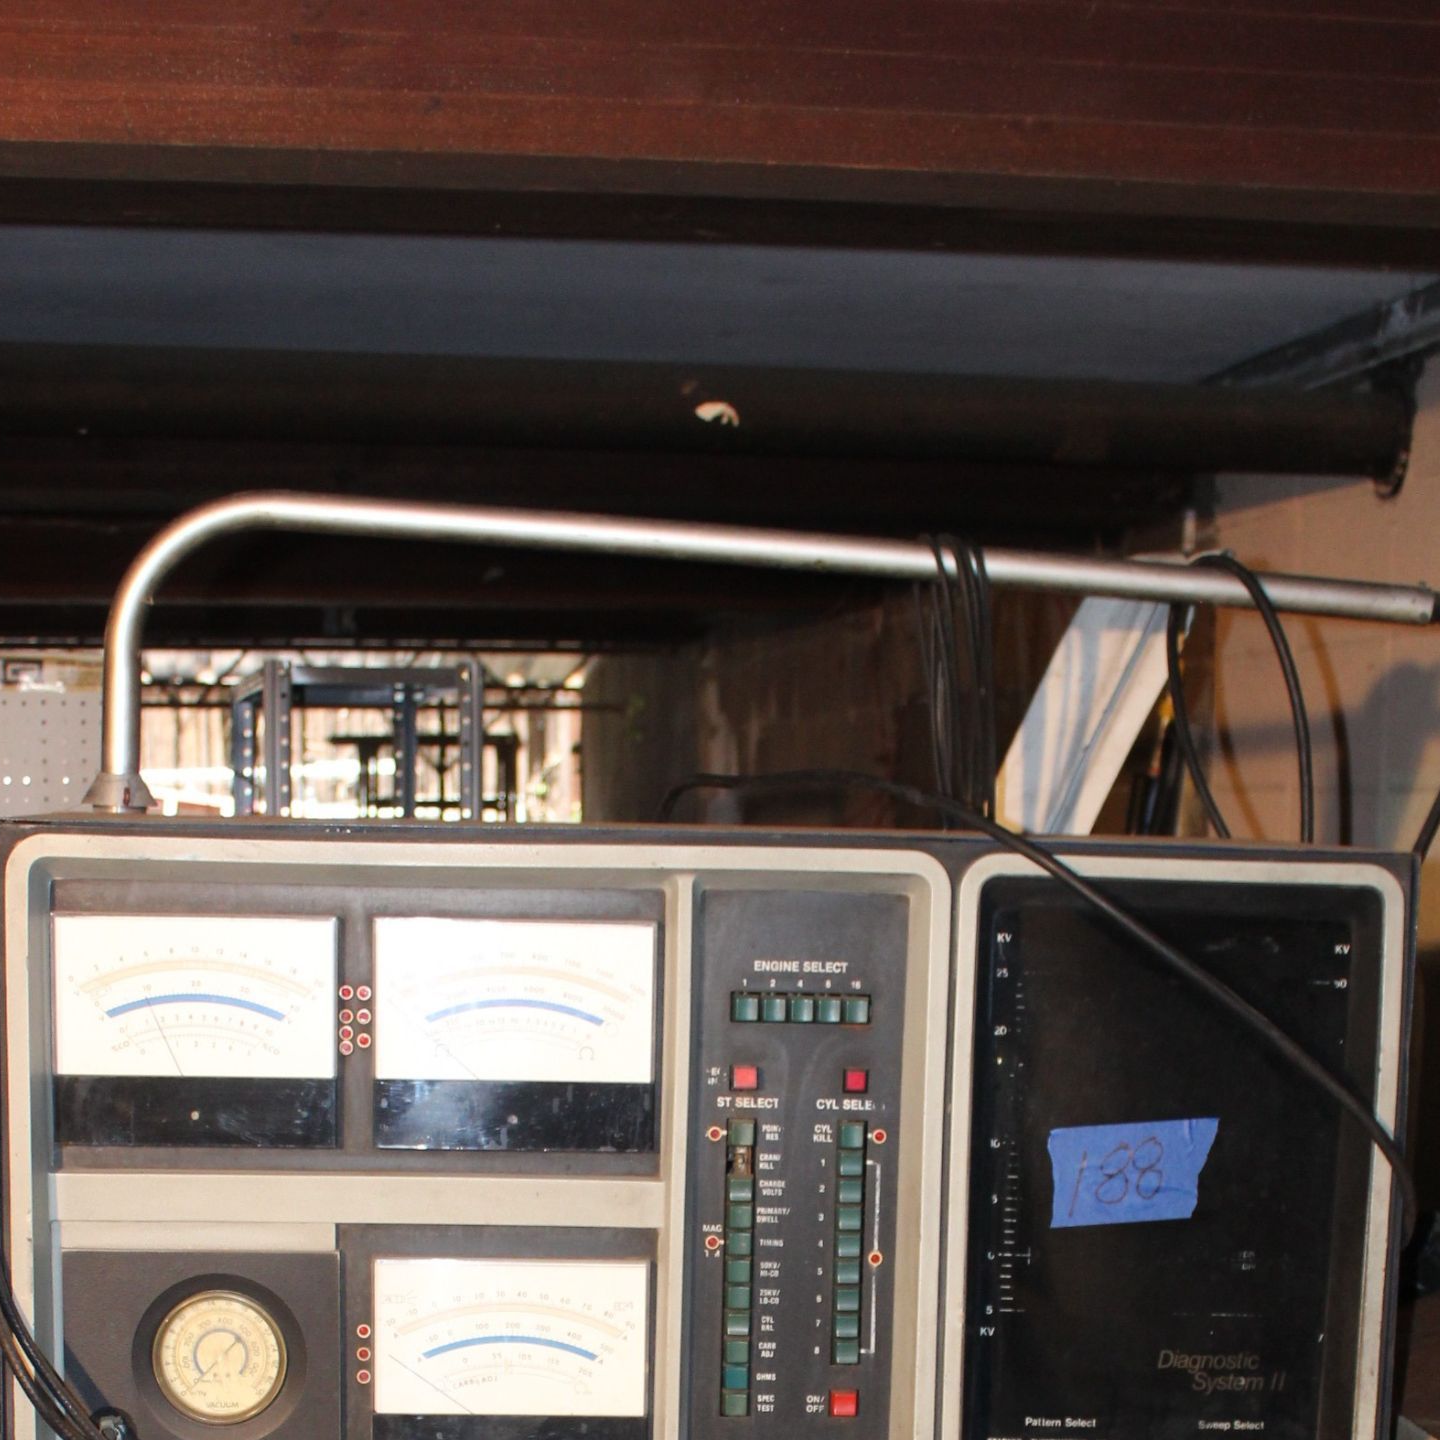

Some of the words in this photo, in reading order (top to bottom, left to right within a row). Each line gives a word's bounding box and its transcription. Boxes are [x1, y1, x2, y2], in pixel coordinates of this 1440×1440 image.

[997, 932, 1012, 943] KV
[1334, 944, 1351, 955] KV
[754, 960, 799, 973] ENGINE
[802, 961, 848, 973] SELECT
[742, 979, 747, 987] 1
[770, 979, 776, 988] 2
[797, 979, 803, 988] 4
[994, 1025, 1007, 1036] 20
[735, 1097, 779, 1108] SELECT
[816, 1099, 839, 1110] CYL
[842, 1099, 886, 1110] SELE
[814, 1125, 832, 1133] CYL
[813, 1134, 833, 1143] KILL
[821, 1159, 825, 1167] 1
[759, 1180, 786, 1188] CHARGE
[762, 1188, 783, 1196] VOLTS
[819, 1185, 825, 1193] 2
[756, 1215, 779, 1224] DWELL
[818, 1214, 824, 1222] 3
[759, 1239, 784, 1247] TIMING
[816, 1295, 822, 1303] 6
[985, 1306, 993, 1315] 5
[761, 1316, 775, 1324] CYL
[815, 1319, 821, 1327] 7
[979, 1327, 995, 1337] KV
[758, 1342, 776, 1350] CARB
[760, 1350, 774, 1358] ADJ
[814, 1347, 820, 1355] 8
[1158, 1349, 1261, 1374] Diagnostic
[756, 1373, 776, 1381] OHMS
[1192, 1371, 1264, 1395] System
[757, 1395, 775, 1403] SPEC
[806, 1395, 825, 1404] ON/
[757, 1404, 775, 1413] TEST
[806, 1405, 824, 1413] OFF
[1025, 1416, 1062, 1427] Pattern
[1065, 1418, 1096, 1428] Select
[1198, 1420, 1231, 1431] Sweep
[1233, 1420, 1264, 1430] Select
